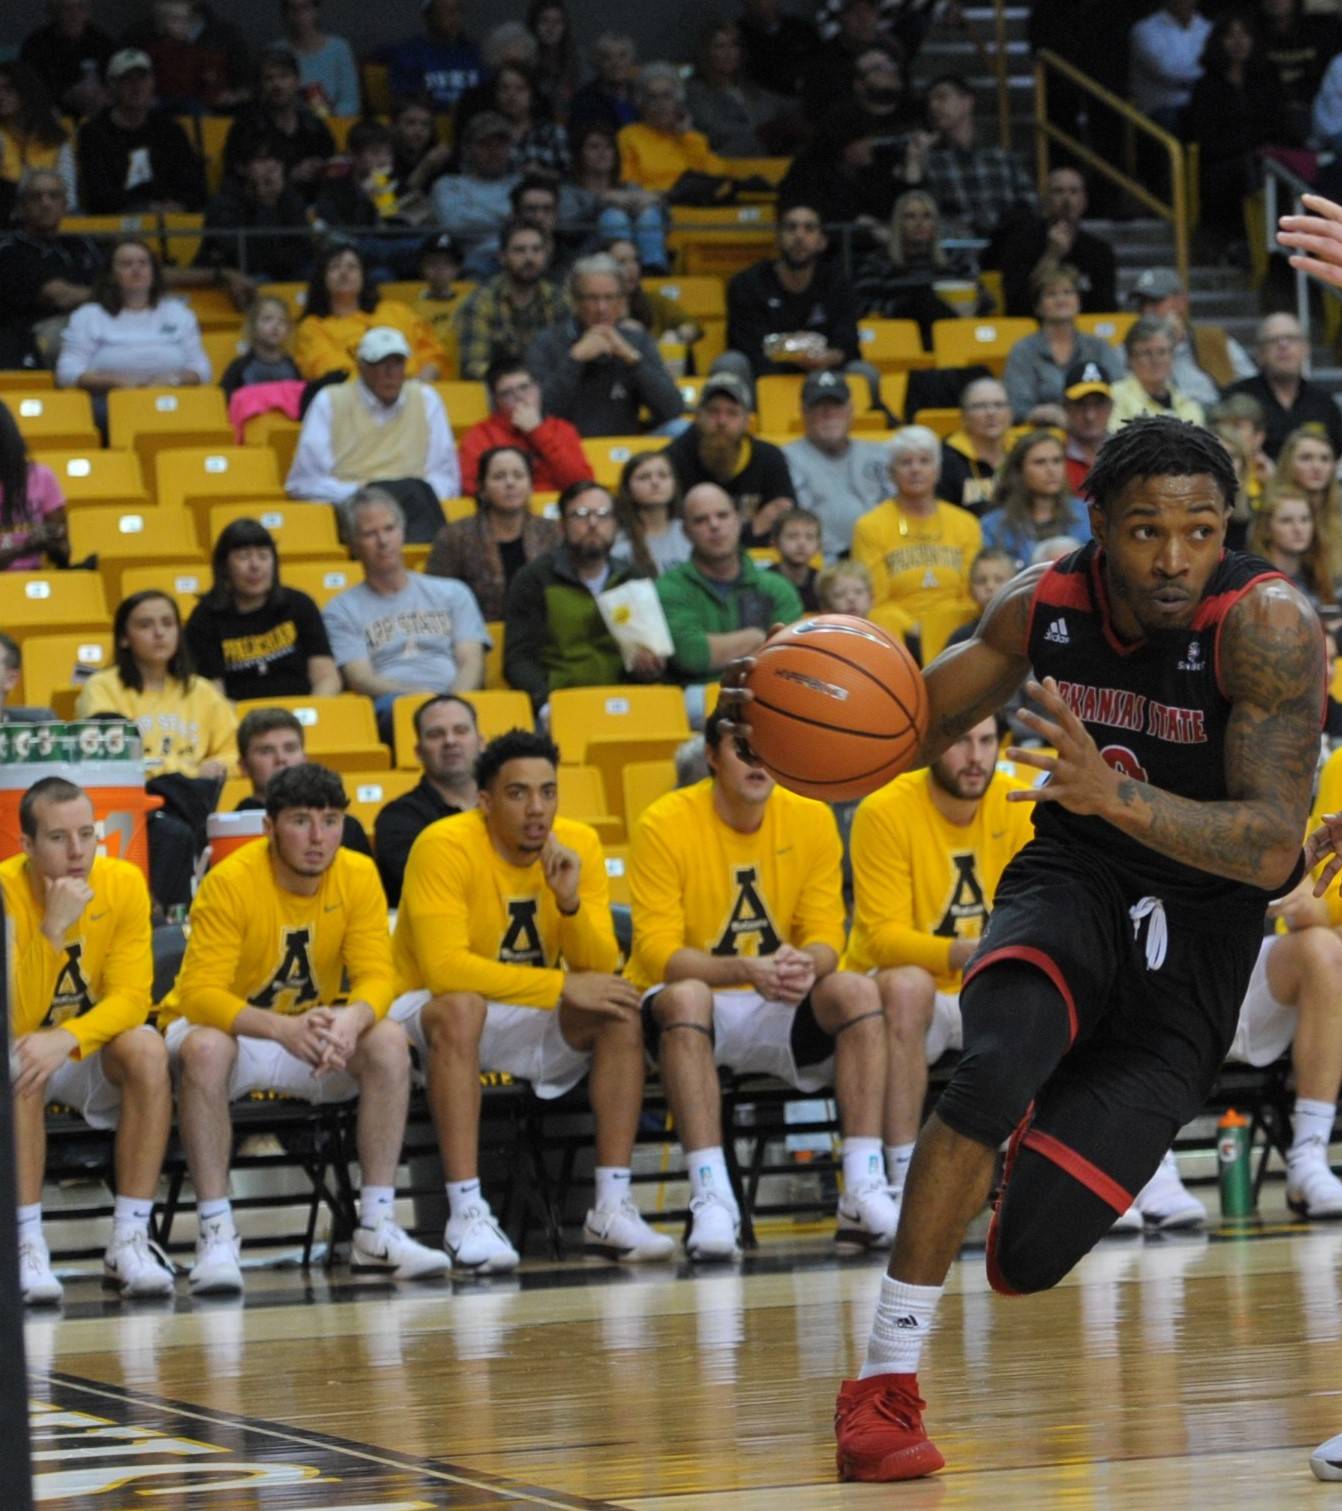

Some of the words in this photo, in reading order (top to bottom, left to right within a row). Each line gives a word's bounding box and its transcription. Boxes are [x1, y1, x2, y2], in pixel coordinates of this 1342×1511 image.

[1058, 680, 1147, 732] RKANSAS
[1147, 699, 1209, 744] STATE
[497, 899, 547, 968] A
[710, 868, 783, 956] A
[932, 853, 992, 938] A
[40, 942, 96, 1028] A
[246, 928, 320, 1008] A
